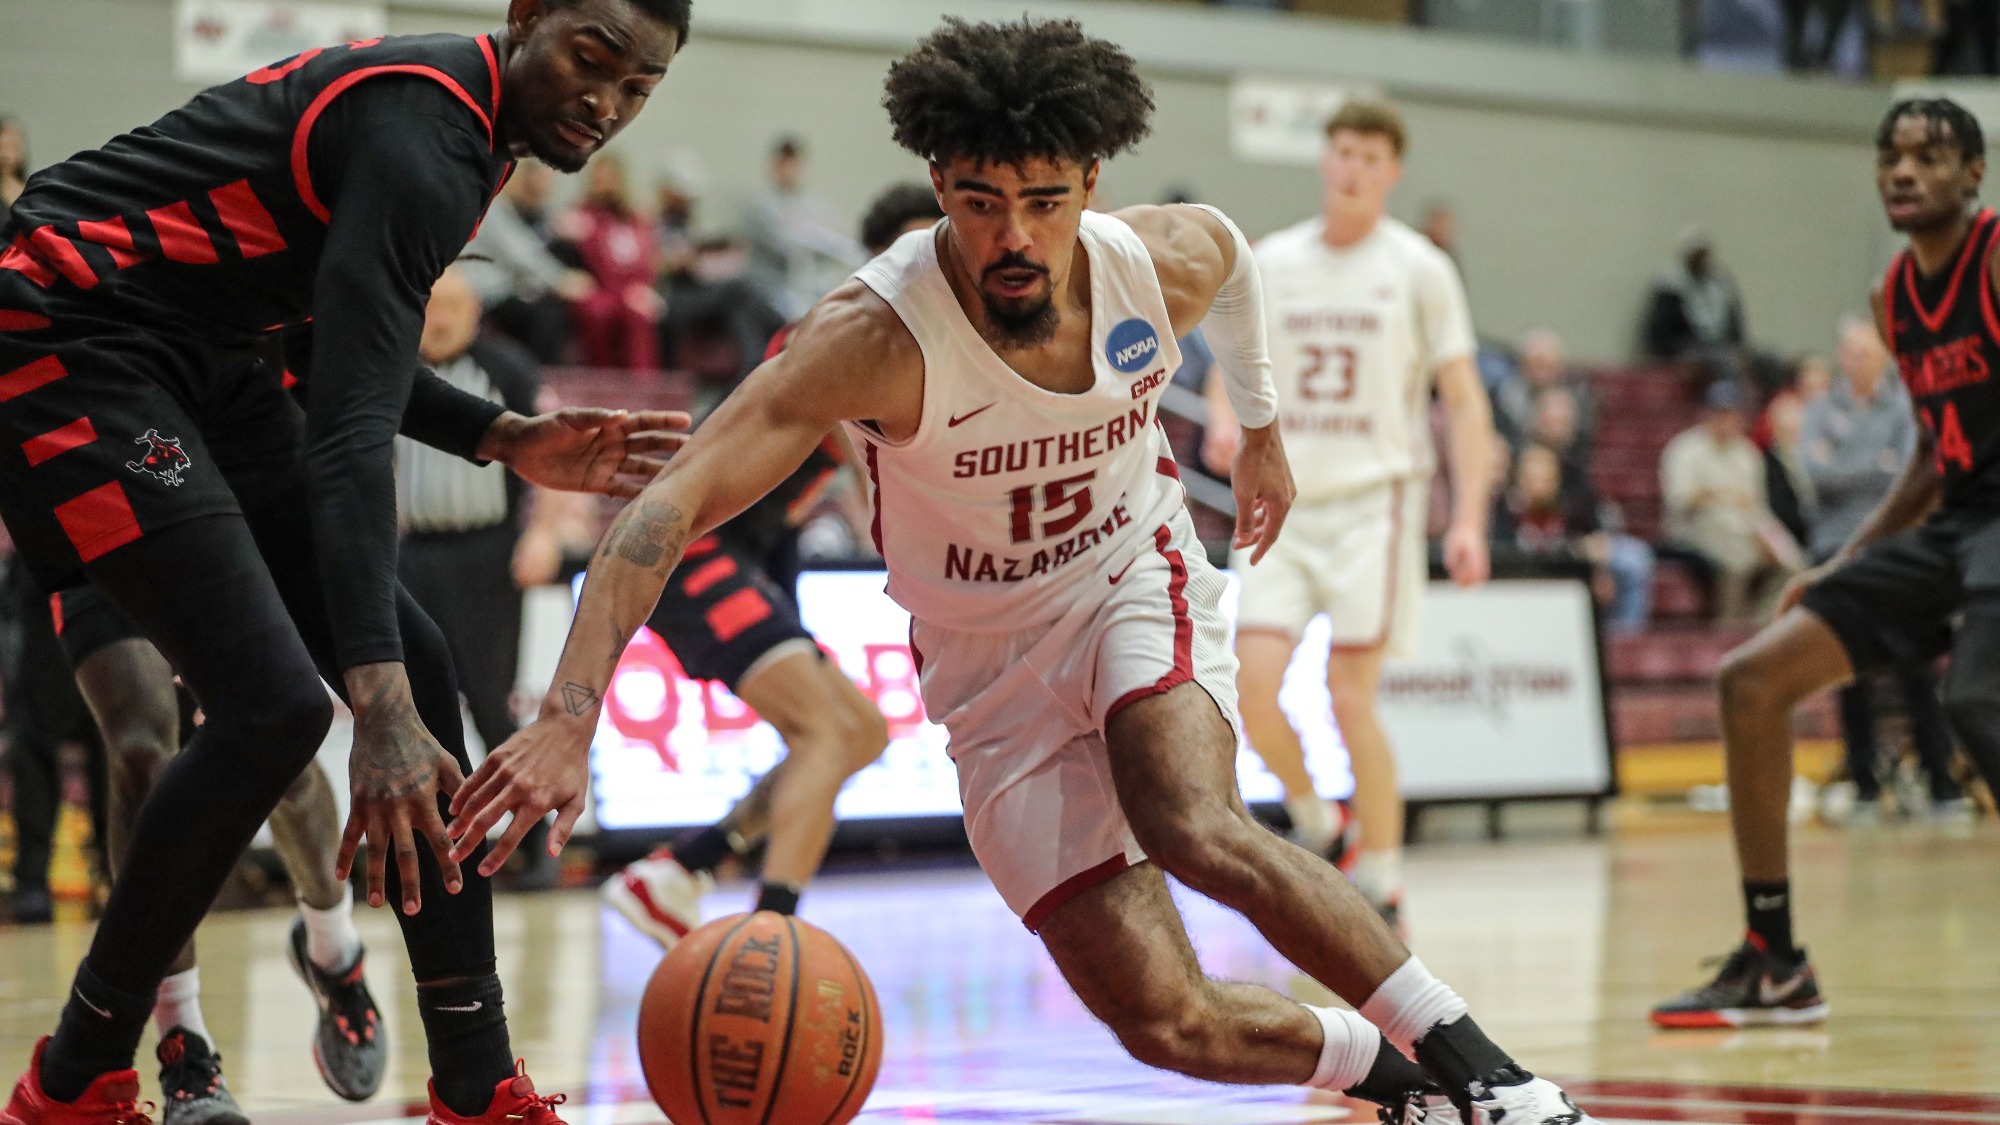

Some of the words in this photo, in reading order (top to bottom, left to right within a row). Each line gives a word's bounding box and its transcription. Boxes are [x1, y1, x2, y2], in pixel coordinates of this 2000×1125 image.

[1116, 335, 1158, 366] NCAA
[1130, 368, 1166, 400] GAC
[1298, 344, 1357, 401] 23
[952, 400, 1149, 479] SOUTHERN
[1003, 469, 1097, 546] 15
[714, 934, 780, 1024] ROCK
[710, 1033, 765, 1110] THE
[837, 1007, 861, 1077] ROCK
